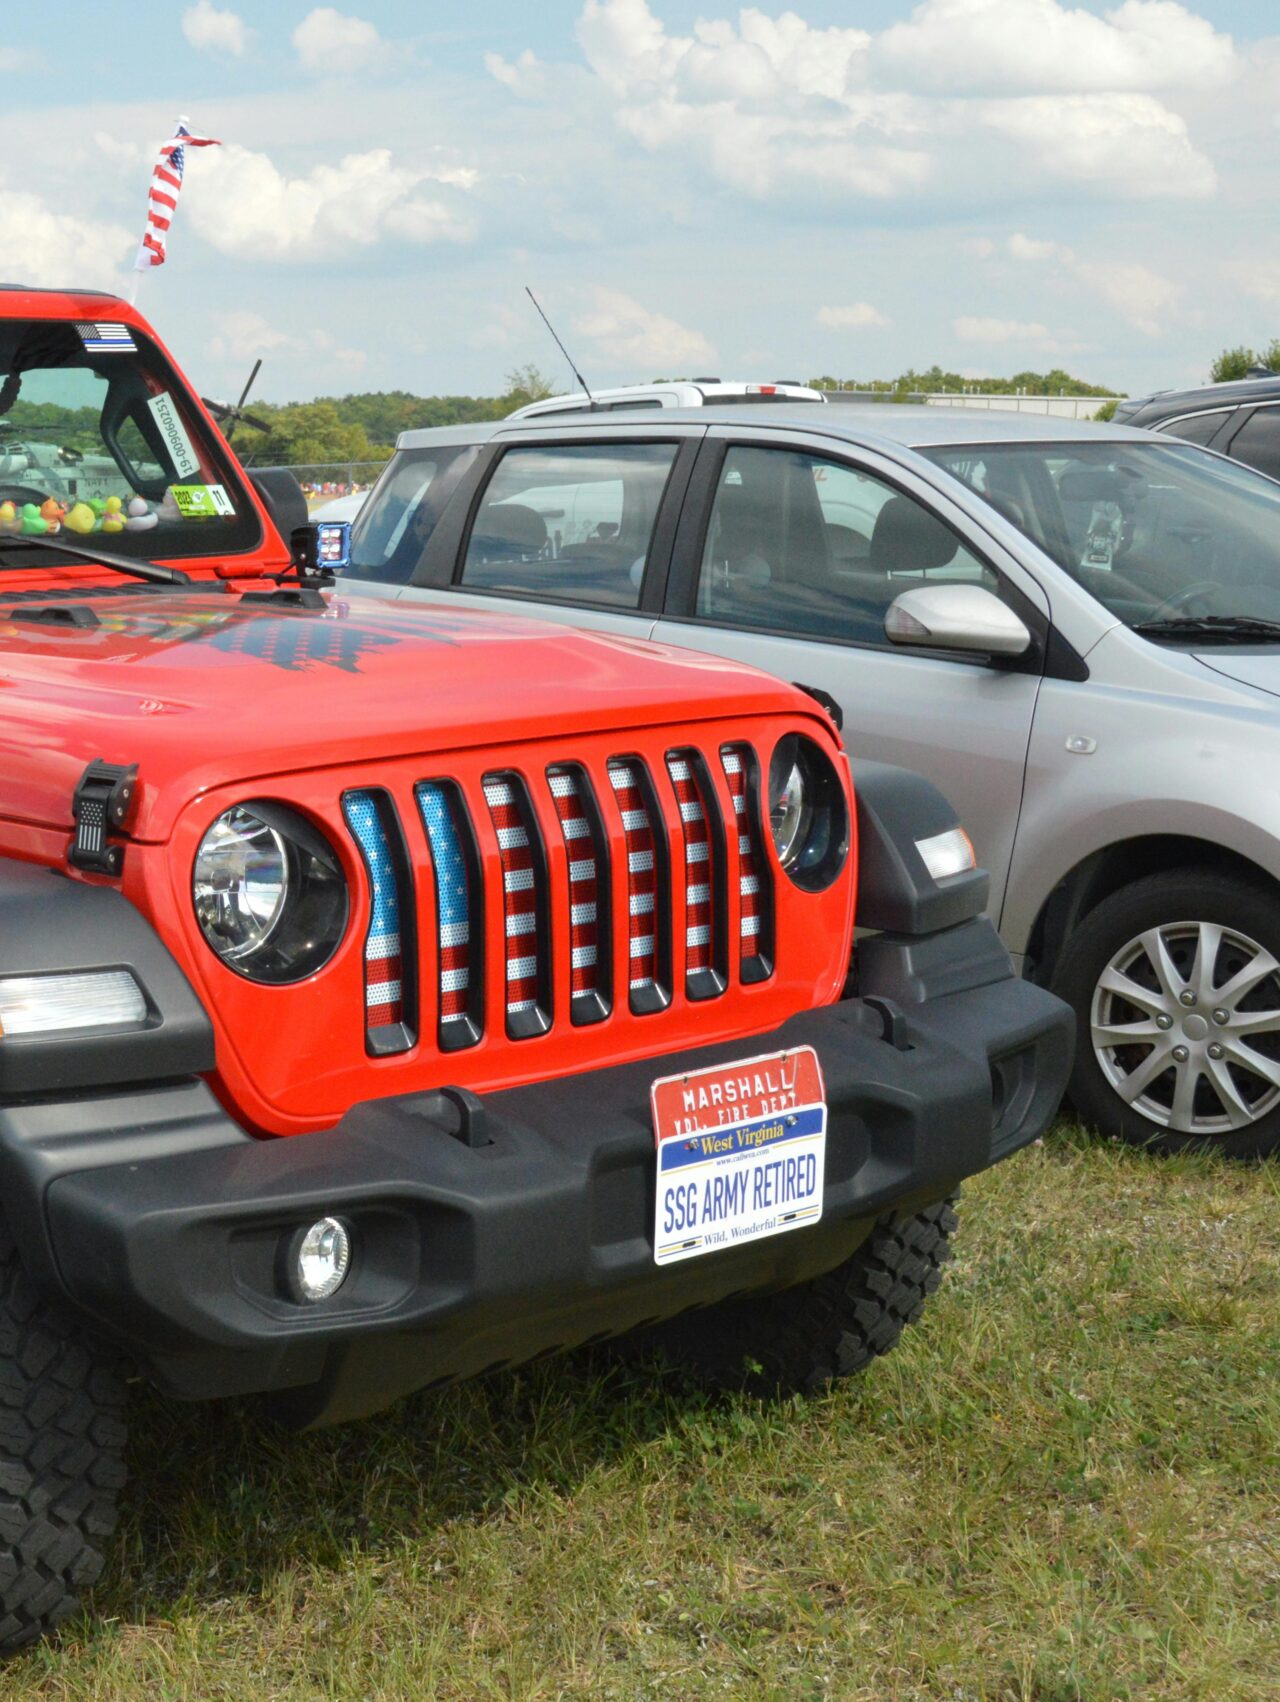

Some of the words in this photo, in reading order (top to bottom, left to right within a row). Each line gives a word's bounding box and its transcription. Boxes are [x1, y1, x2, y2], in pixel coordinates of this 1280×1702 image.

[155, 397, 193, 475] 19-009060251
[682, 1068, 795, 1113] MARSHALL
[718, 1105, 750, 1125] FIRE
[701, 1134, 734, 1156] West
[736, 1120, 785, 1147] Virginia
[664, 1182, 697, 1234] SSG
[702, 1169, 750, 1224] ARMY
[752, 1152, 817, 1211] RETIRED
[703, 1228, 729, 1247] Wild,
[730, 1215, 777, 1239] Wonderful
